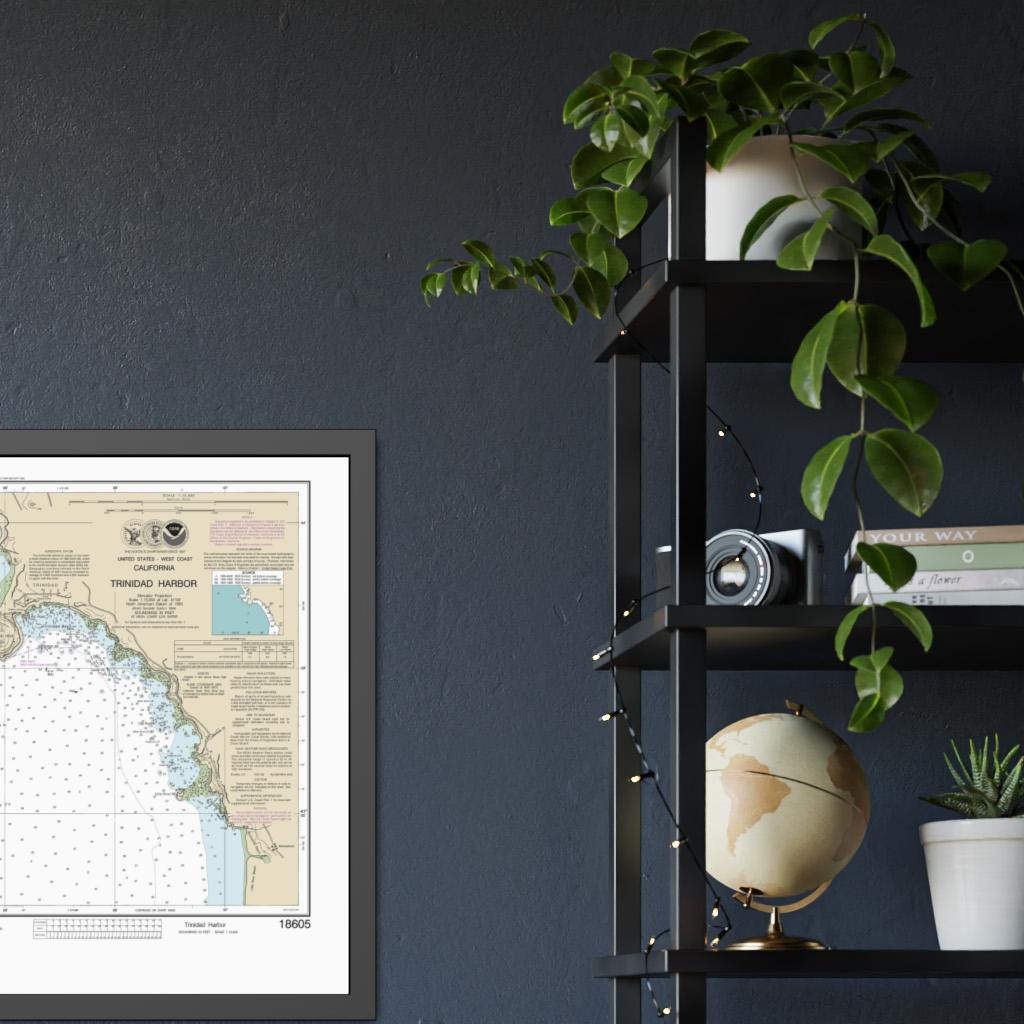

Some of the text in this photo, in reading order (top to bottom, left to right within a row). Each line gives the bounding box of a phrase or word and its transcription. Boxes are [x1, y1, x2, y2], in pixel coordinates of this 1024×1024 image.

[870, 530, 977, 543] YOUR WAY
[110, 579, 198, 588] TRINIDAD HARBOR
[927, 573, 961, 590] flower
[279, 919, 311, 929] 18605
